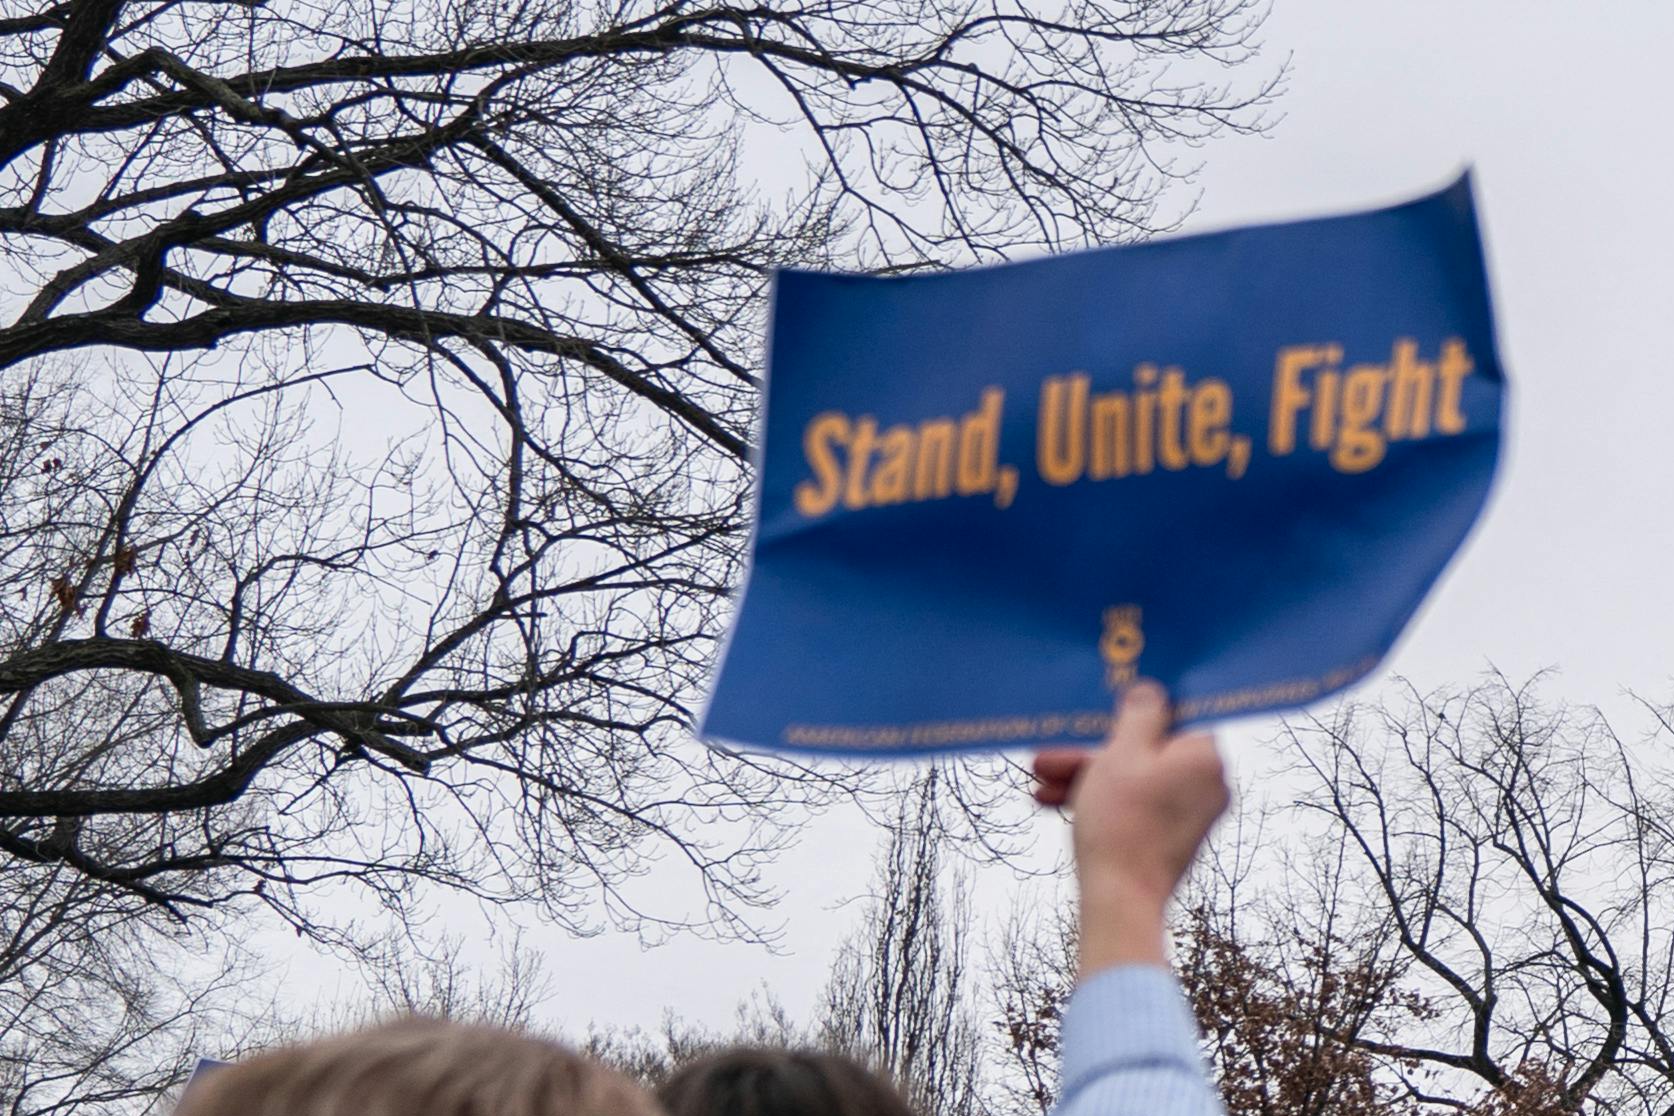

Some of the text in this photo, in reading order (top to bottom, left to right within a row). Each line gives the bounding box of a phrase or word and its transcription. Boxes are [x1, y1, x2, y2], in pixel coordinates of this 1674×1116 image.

[796, 337, 1474, 517] Stand, Unite, Fight
